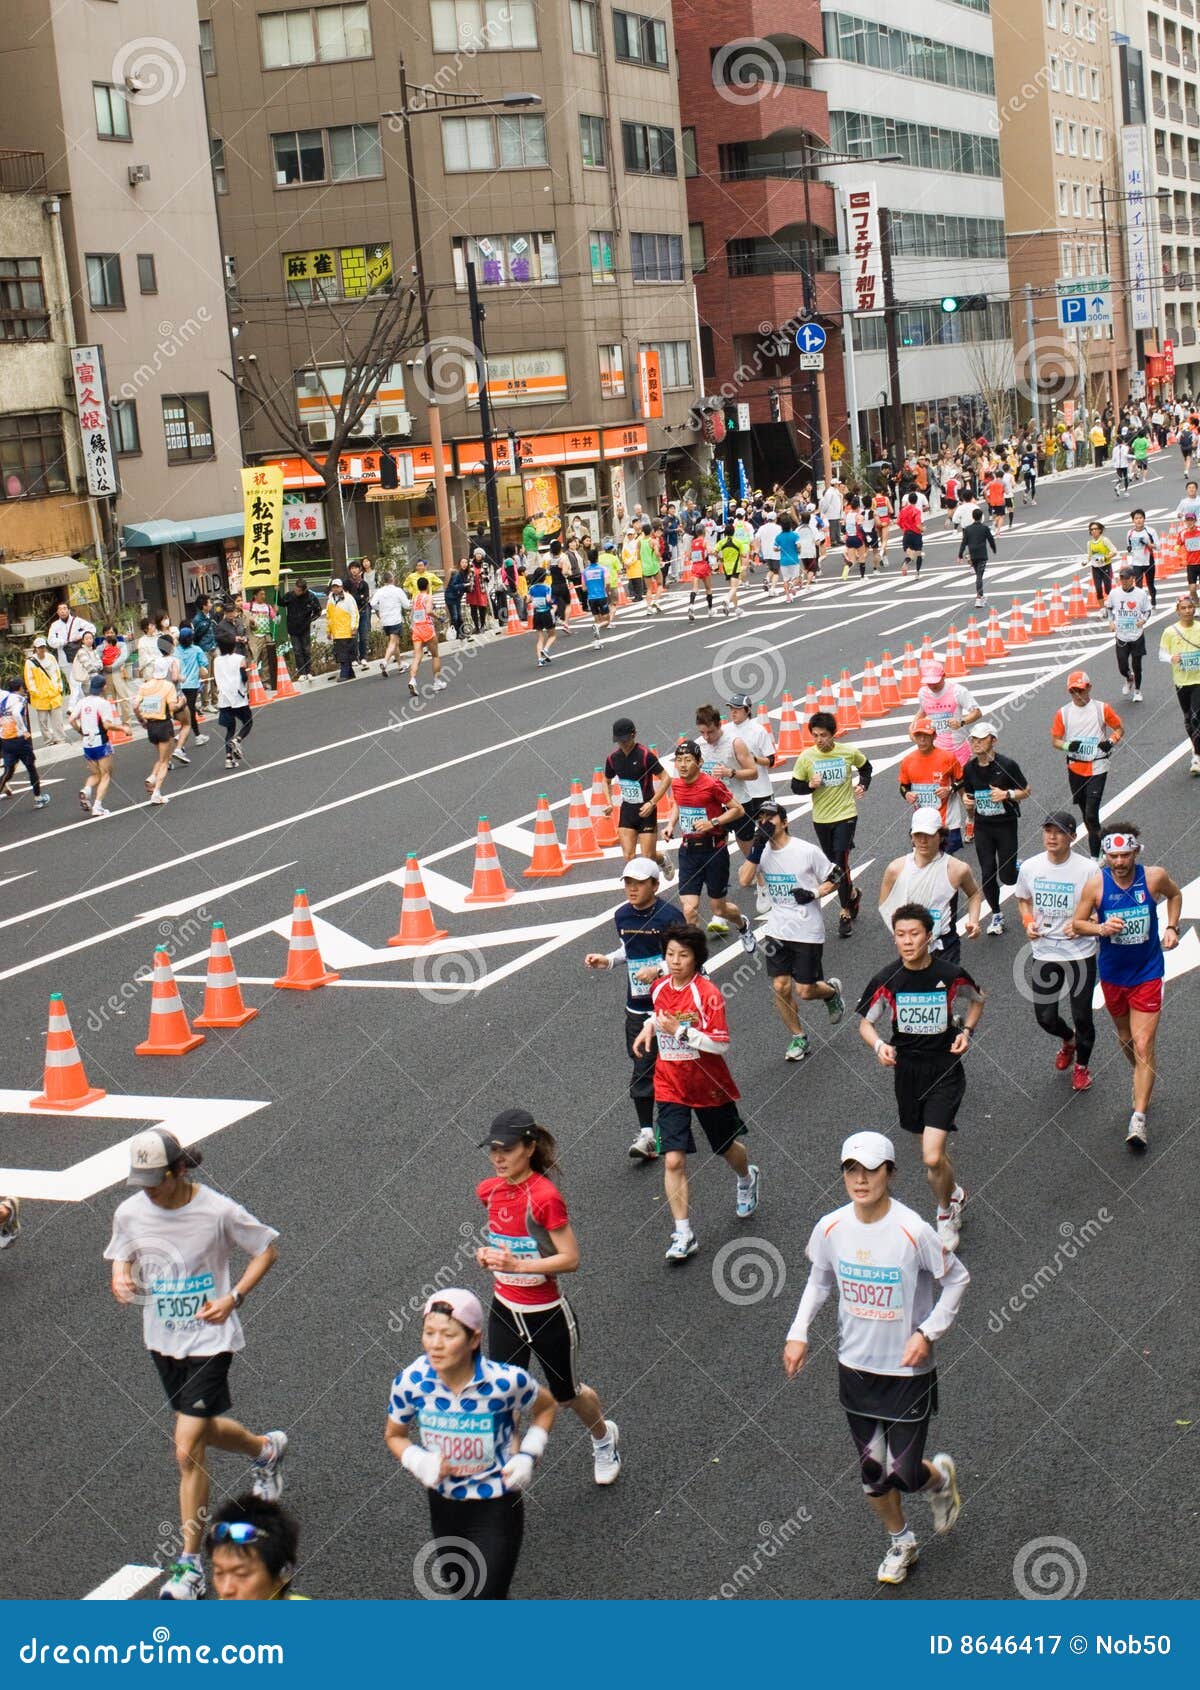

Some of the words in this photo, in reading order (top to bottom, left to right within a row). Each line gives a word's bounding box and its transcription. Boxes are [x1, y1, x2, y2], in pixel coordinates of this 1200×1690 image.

[287, 253, 334, 277] 麻雀
[1066, 300, 1081, 322] P
[496, 442, 534, 458] 吉家
[338, 456, 376, 472] 吉家
[253, 471, 269, 486] 祝
[248, 496, 275, 577] 松野仁一
[1034, 892, 1069, 909] B23164
[899, 1007, 941, 1025] C25647
[841, 1280, 893, 1308] E50927
